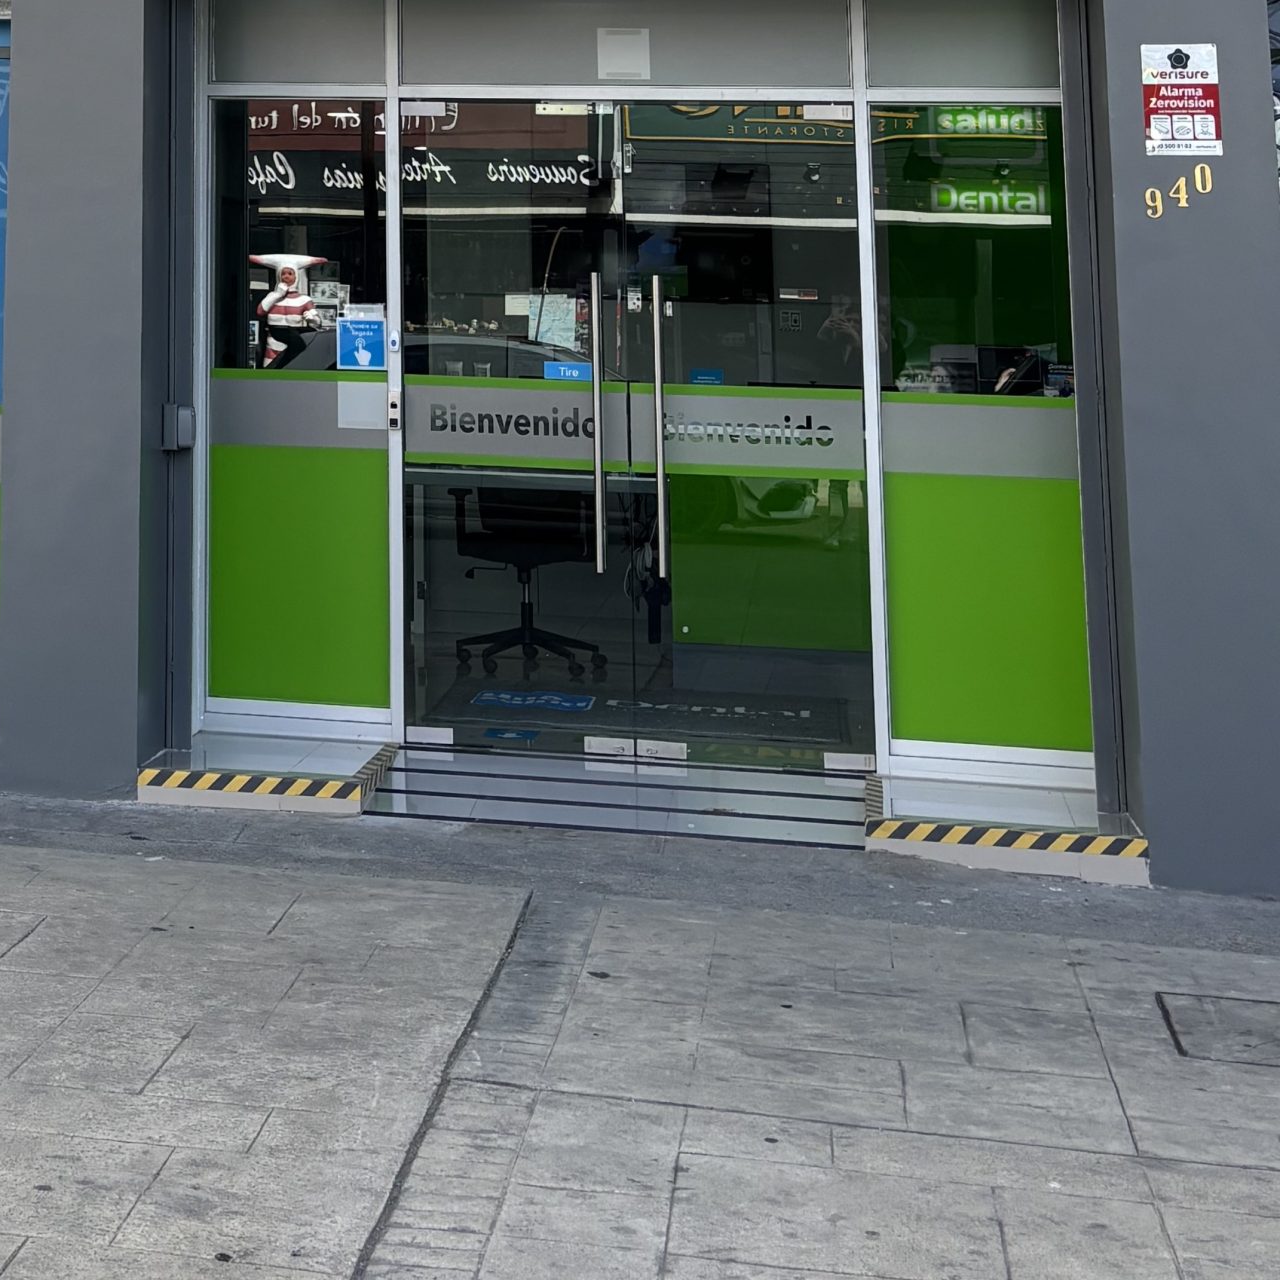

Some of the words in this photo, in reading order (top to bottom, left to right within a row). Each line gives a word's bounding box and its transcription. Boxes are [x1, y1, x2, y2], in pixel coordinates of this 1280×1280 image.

[1151, 70, 1209, 80] verisure
[1159, 86, 1203, 97] Alarma
[1149, 97, 1215, 109] Zerovision
[1145, 163, 1213, 219] 940
[930, 183, 1045, 214] Dental
[558, 366, 579, 378] Tire
